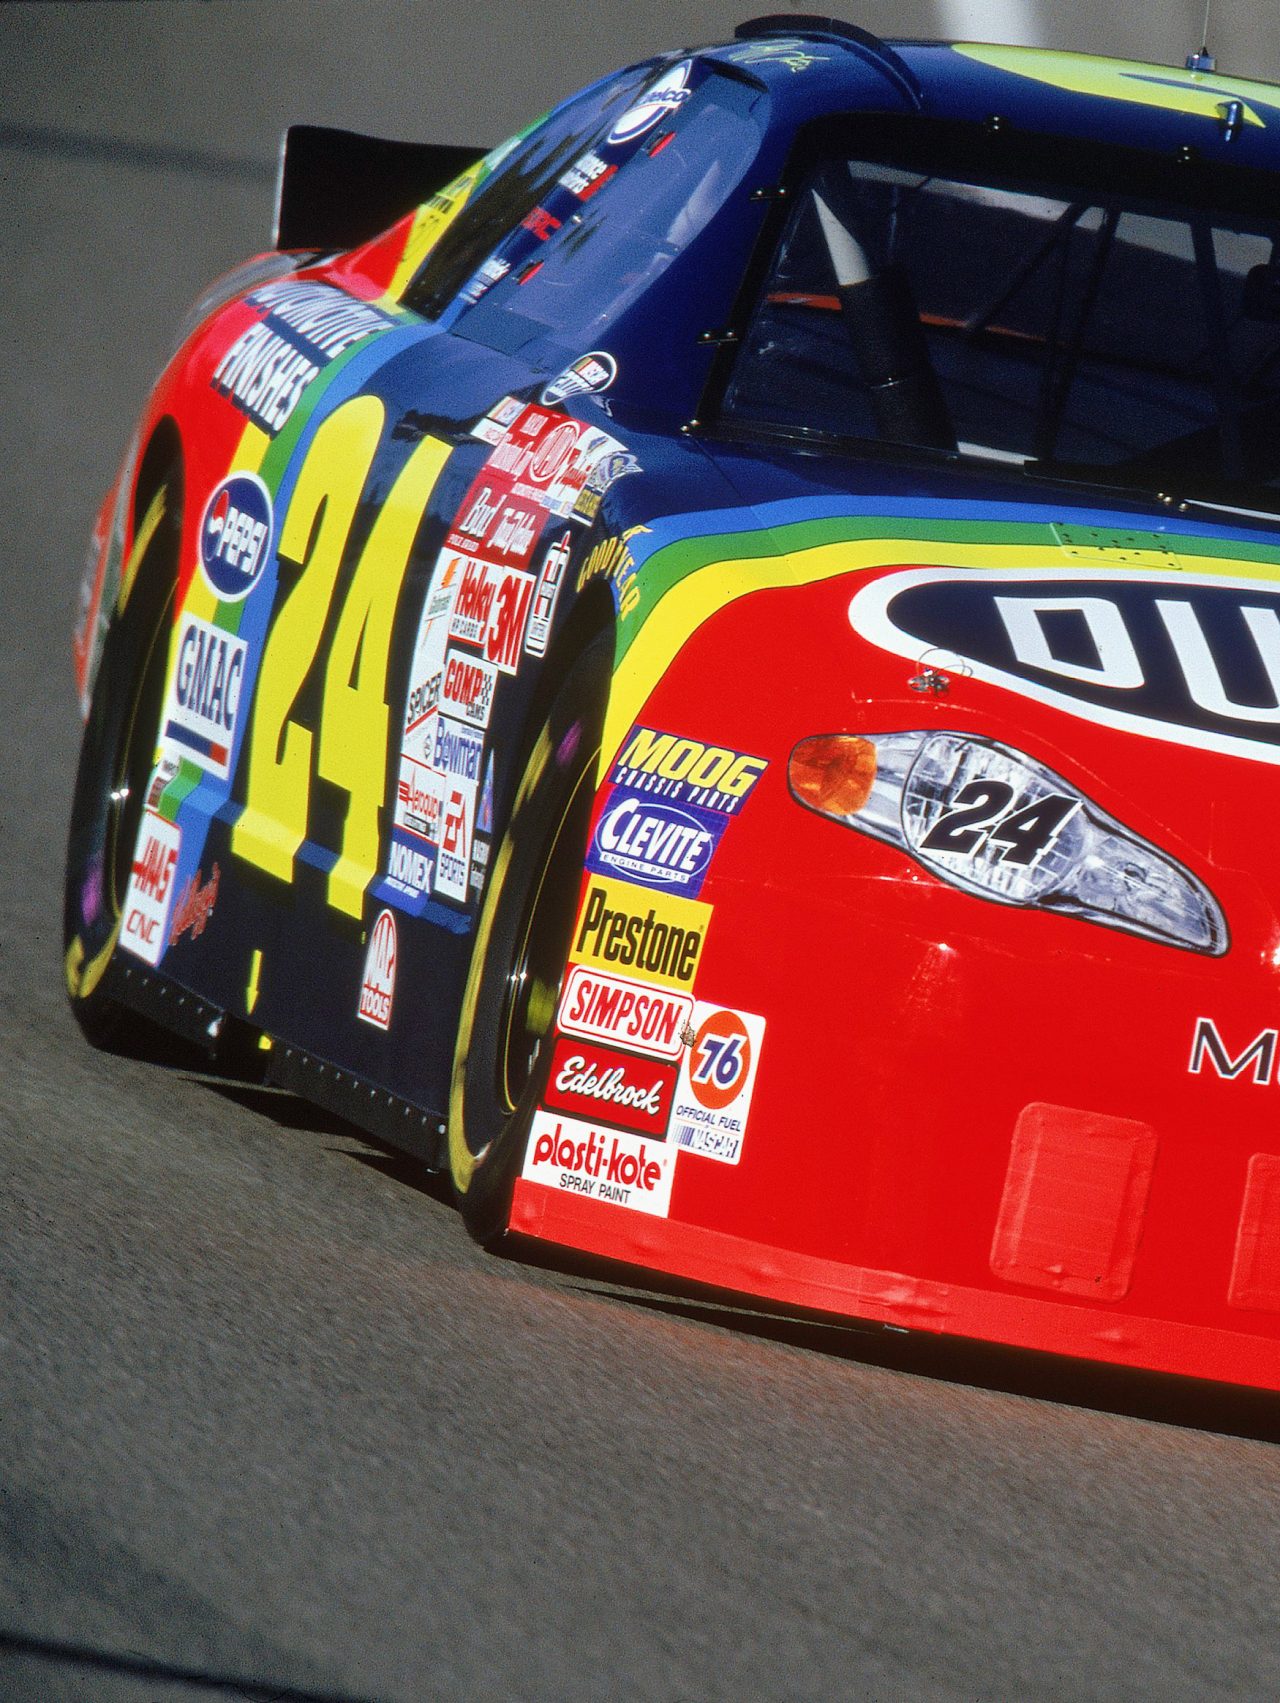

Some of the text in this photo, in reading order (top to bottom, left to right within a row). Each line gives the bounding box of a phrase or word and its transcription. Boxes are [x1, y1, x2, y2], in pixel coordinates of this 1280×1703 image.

[214, 322, 320, 432] FINISHES
[217, 506, 269, 577] PEPSI
[576, 524, 654, 621] GOODYEAR
[454, 560, 497, 641] Holley
[487, 575, 533, 668] 3M
[176, 625, 243, 731] GMAC
[231, 394, 454, 921] 24
[444, 658, 484, 706] COMP
[616, 767, 740, 813] CHASSIS PARTS
[617, 728, 768, 797] MOOG
[918, 779, 1083, 867] 24
[388, 841, 435, 894] NOMEX
[602, 853, 688, 882] ENGINE PARTS
[126, 909, 160, 944] CNC
[576, 887, 702, 981] Prestone
[361, 988, 391, 1021] TOOLS
[569, 979, 683, 1045] SIMPSON
[555, 1055, 664, 1115] Edelbrock
[694, 1035, 745, 1089] 76
[675, 1105, 742, 1132] OFFICIAL FUEL
[532, 1123, 662, 1191] plasti-kote
[559, 1173, 631, 1204] SPRAY PAINT
